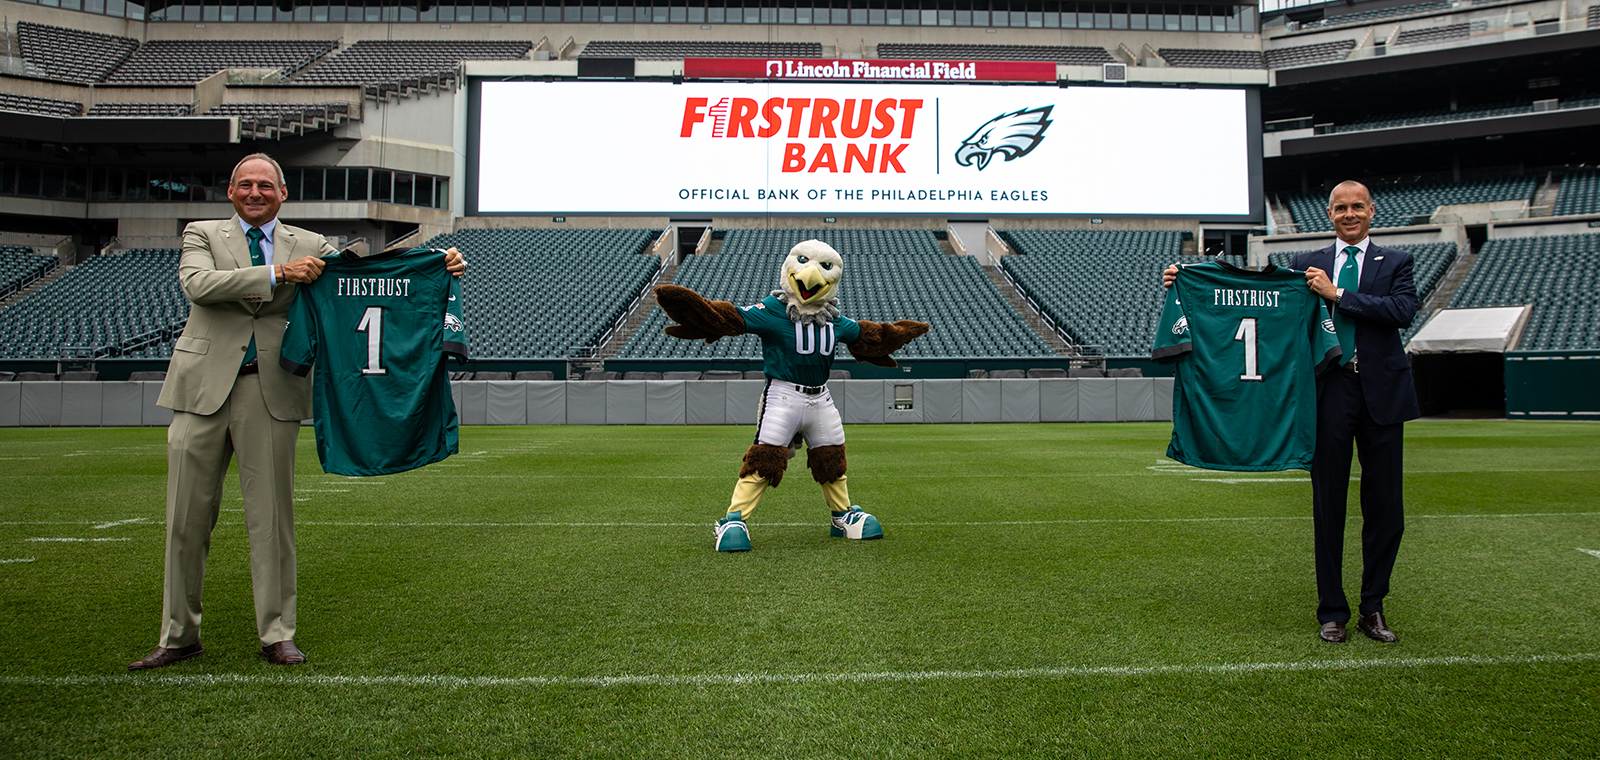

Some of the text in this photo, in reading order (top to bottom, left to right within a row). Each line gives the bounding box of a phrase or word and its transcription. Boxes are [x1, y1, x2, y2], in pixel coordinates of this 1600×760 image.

[785, 60, 977, 80] Lincoln Financial Field
[781, 143, 907, 174] BANK
[678, 188, 1048, 202] OFFICIAL BANK OF THE PHILADELPHIA EAGLES
[337, 278, 410, 297] FIRSTRUST
[1214, 288, 1280, 308] FIRSTRUST
[356, 306, 389, 376] 1
[1234, 317, 1264, 382] 1
